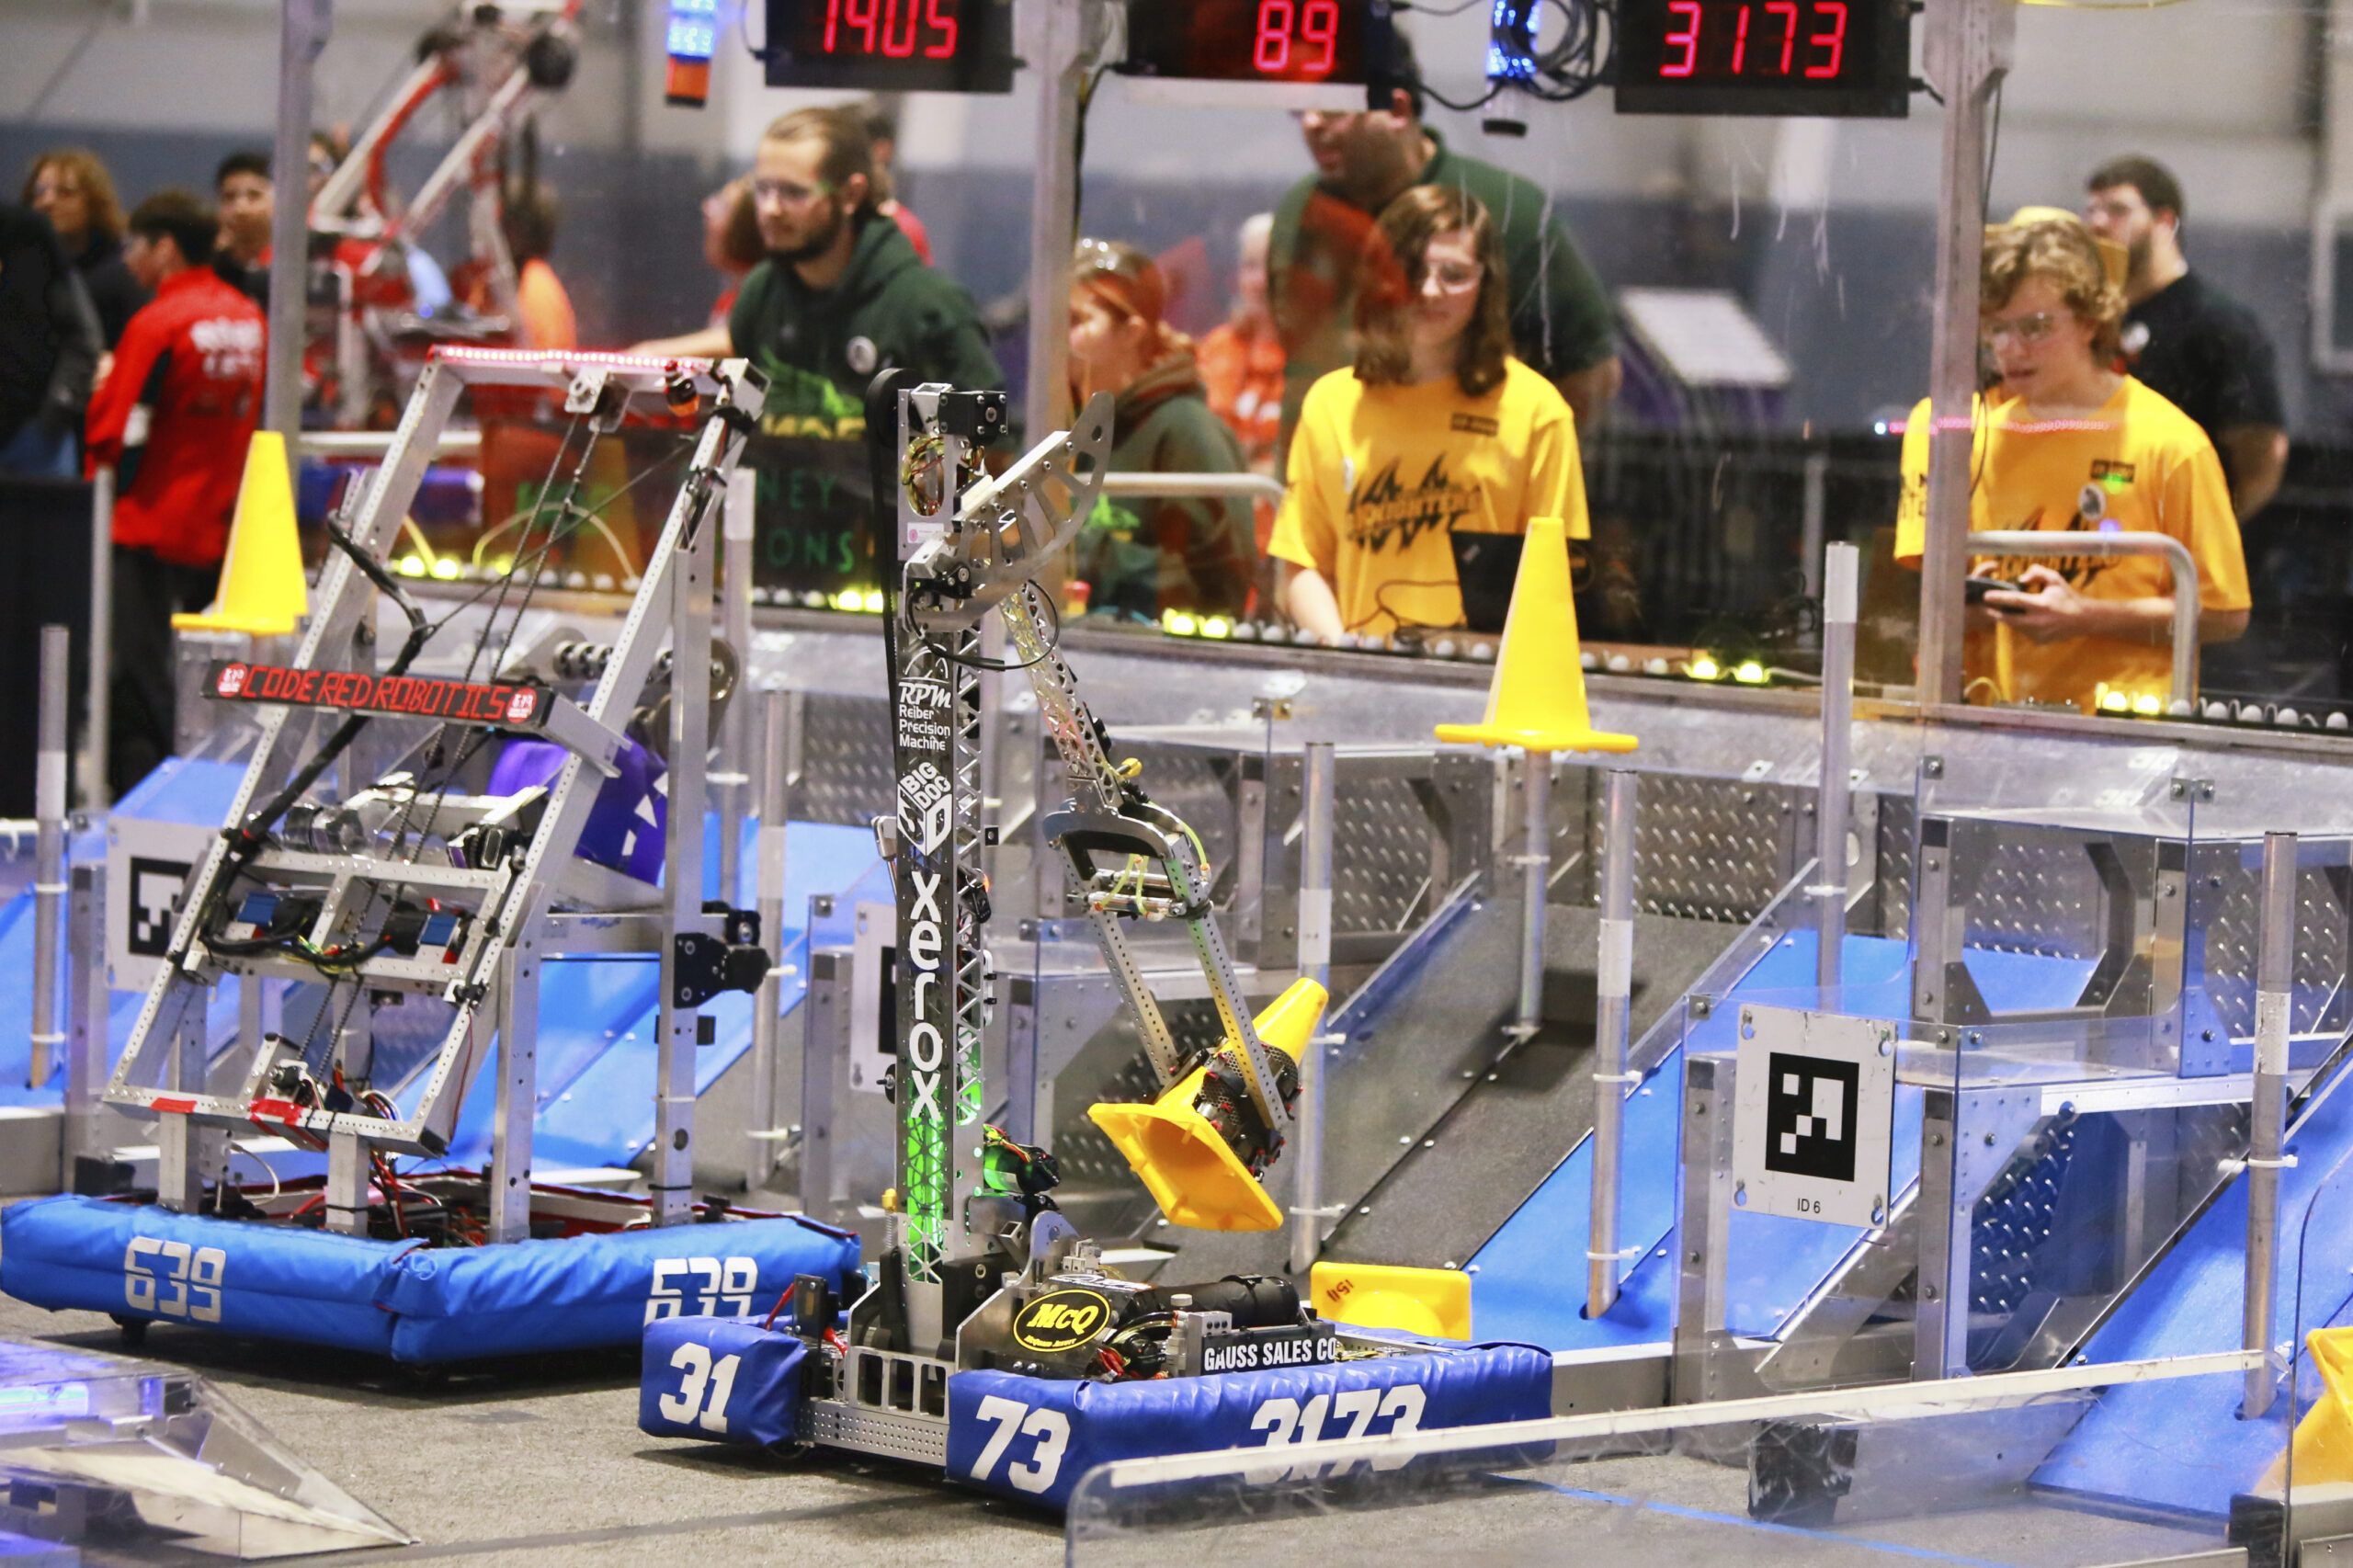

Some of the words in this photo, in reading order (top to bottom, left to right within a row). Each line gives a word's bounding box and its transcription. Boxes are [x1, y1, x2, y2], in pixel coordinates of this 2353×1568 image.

[824, 0, 958, 58] 1405
[1253, 0, 1339, 73] 89
[1659, 1, 1847, 78] 3173
[241, 665, 322, 703] CODE
[315, 671, 373, 709] RED
[370, 676, 513, 720] ROBOTICS
[898, 682, 952, 709] RPM
[899, 704, 934, 720] Reiber
[899, 719, 951, 737] Precision
[900, 733, 947, 752] Machine
[900, 761, 938, 795] BIG
[913, 775, 952, 810] DOG
[909, 870, 944, 1121] xerox
[1797, 1198, 1811, 1212] ID
[1813, 1199, 1822, 1214] 6
[124, 1235, 227, 1324] 639
[1204, 1344, 1258, 1371] GAUSS
[1262, 1338, 1313, 1366] SALES
[1316, 1336, 1337, 1361] CO
[658, 1341, 742, 1434] 31
[970, 1393, 1072, 1494] 73
[1244, 1383, 1427, 1485] 3173
